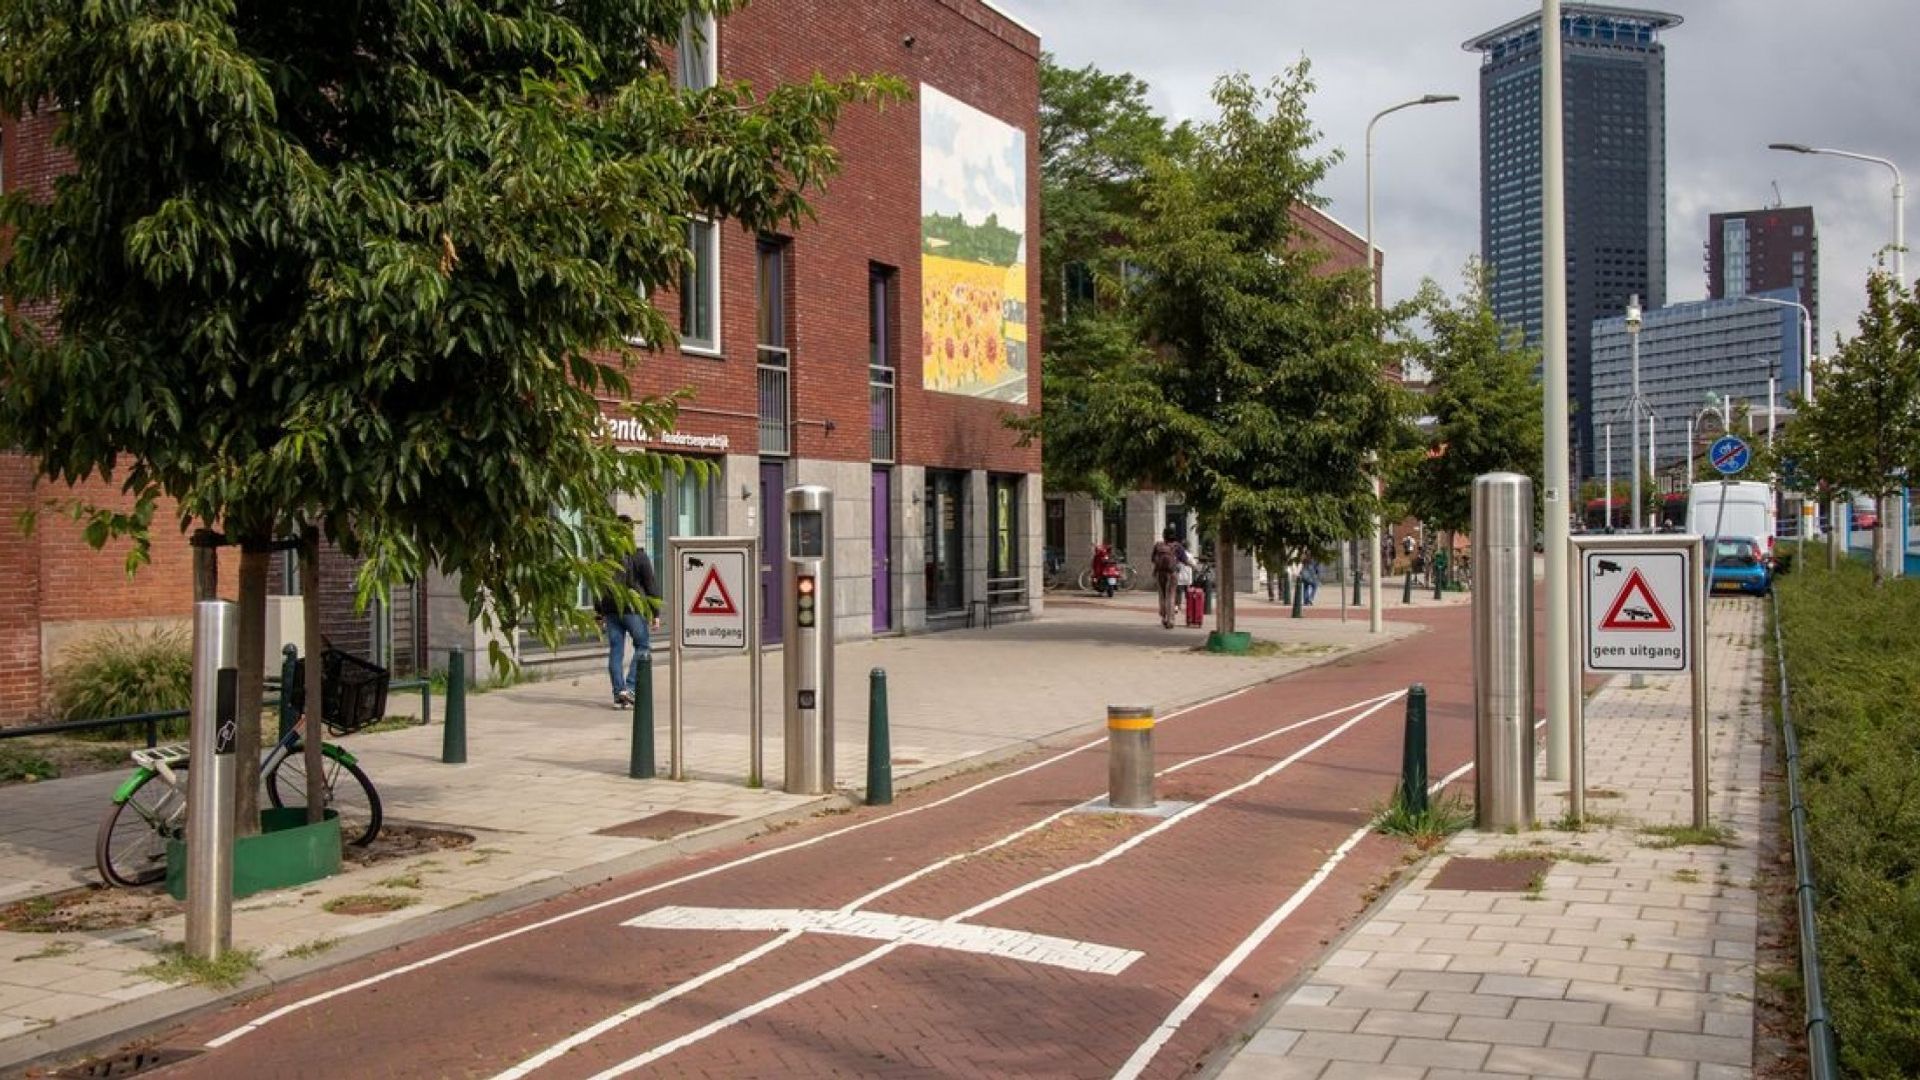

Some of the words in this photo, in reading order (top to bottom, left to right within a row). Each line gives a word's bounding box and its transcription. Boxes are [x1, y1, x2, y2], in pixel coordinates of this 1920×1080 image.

[685, 627, 707, 638] geen
[708, 626, 742, 639] uitgang
[1593, 646, 1625, 658] geen
[1629, 644, 1681, 659] uitgang
